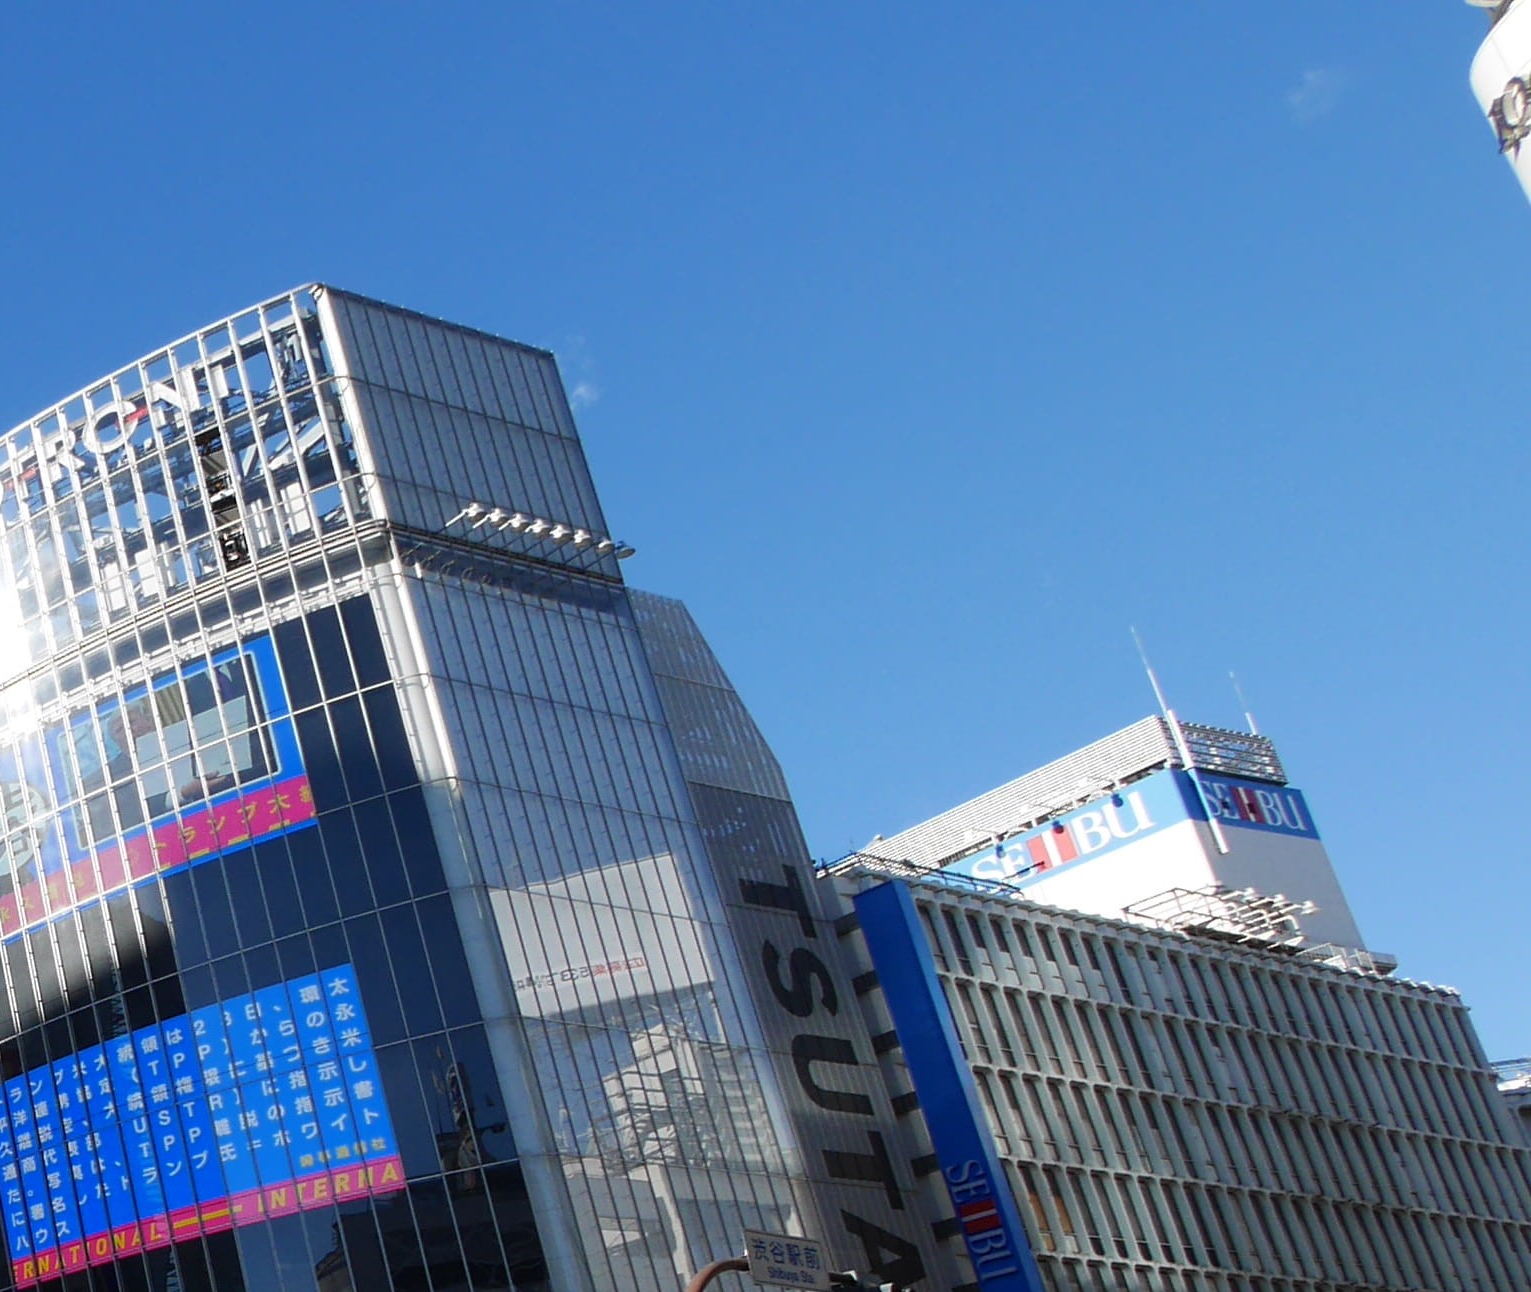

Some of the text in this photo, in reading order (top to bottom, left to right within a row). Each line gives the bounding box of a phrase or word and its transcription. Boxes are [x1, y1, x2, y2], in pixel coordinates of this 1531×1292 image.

[1201, 781, 1307, 831] SEIBU
[971, 792, 1155, 888] SEIBU
[2, 1056, 369, 1182] 通商代表部USTR）に指示し
[13, 1220, 164, 1284] ERNATONAL
[15, 1220, 72, 1252] ハウス
[946, 1159, 1017, 1281] SEIBU
[751, 1238, 820, 1270] 渋谷駅前
